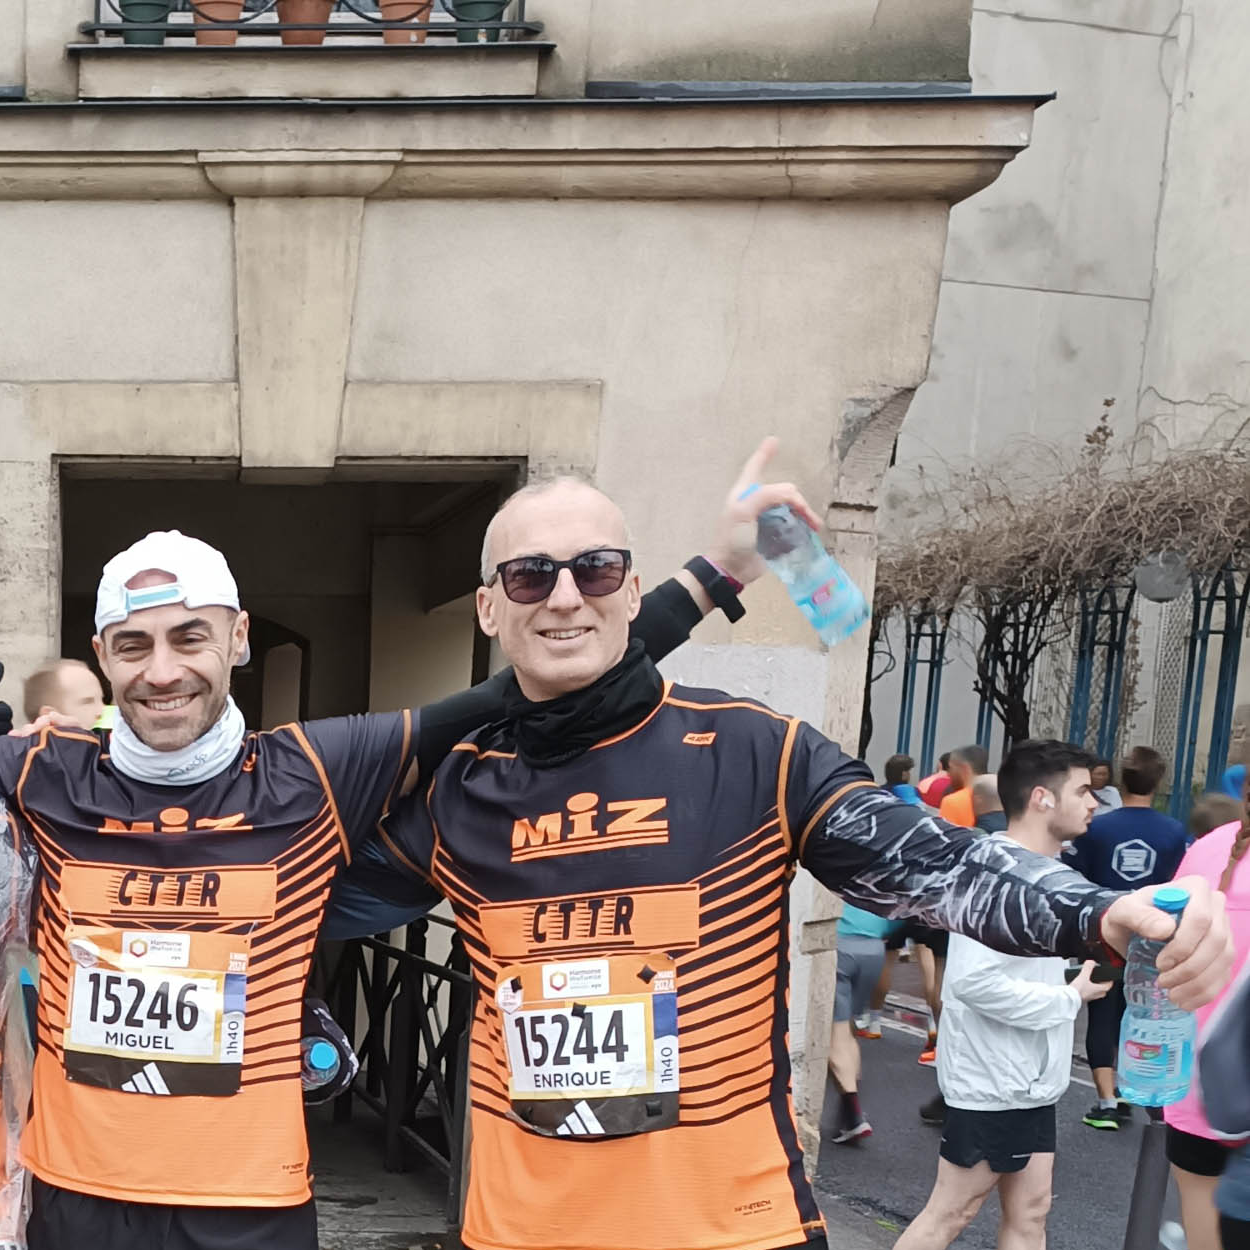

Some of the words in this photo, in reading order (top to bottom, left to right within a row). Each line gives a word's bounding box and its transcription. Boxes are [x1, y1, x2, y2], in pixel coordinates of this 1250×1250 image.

[512, 792, 668, 849] MiZ
[118, 870, 221, 907] CTTR
[532, 896, 634, 943] CTTR
[88, 972, 199, 1032] 15246
[105, 1031, 174, 1050] MIGUEL
[226, 1021, 239, 1055] 1h40
[514, 1010, 629, 1067] 15244
[534, 1071, 612, 1088] ENRIQUE
[661, 1047, 673, 1083] 1h40
